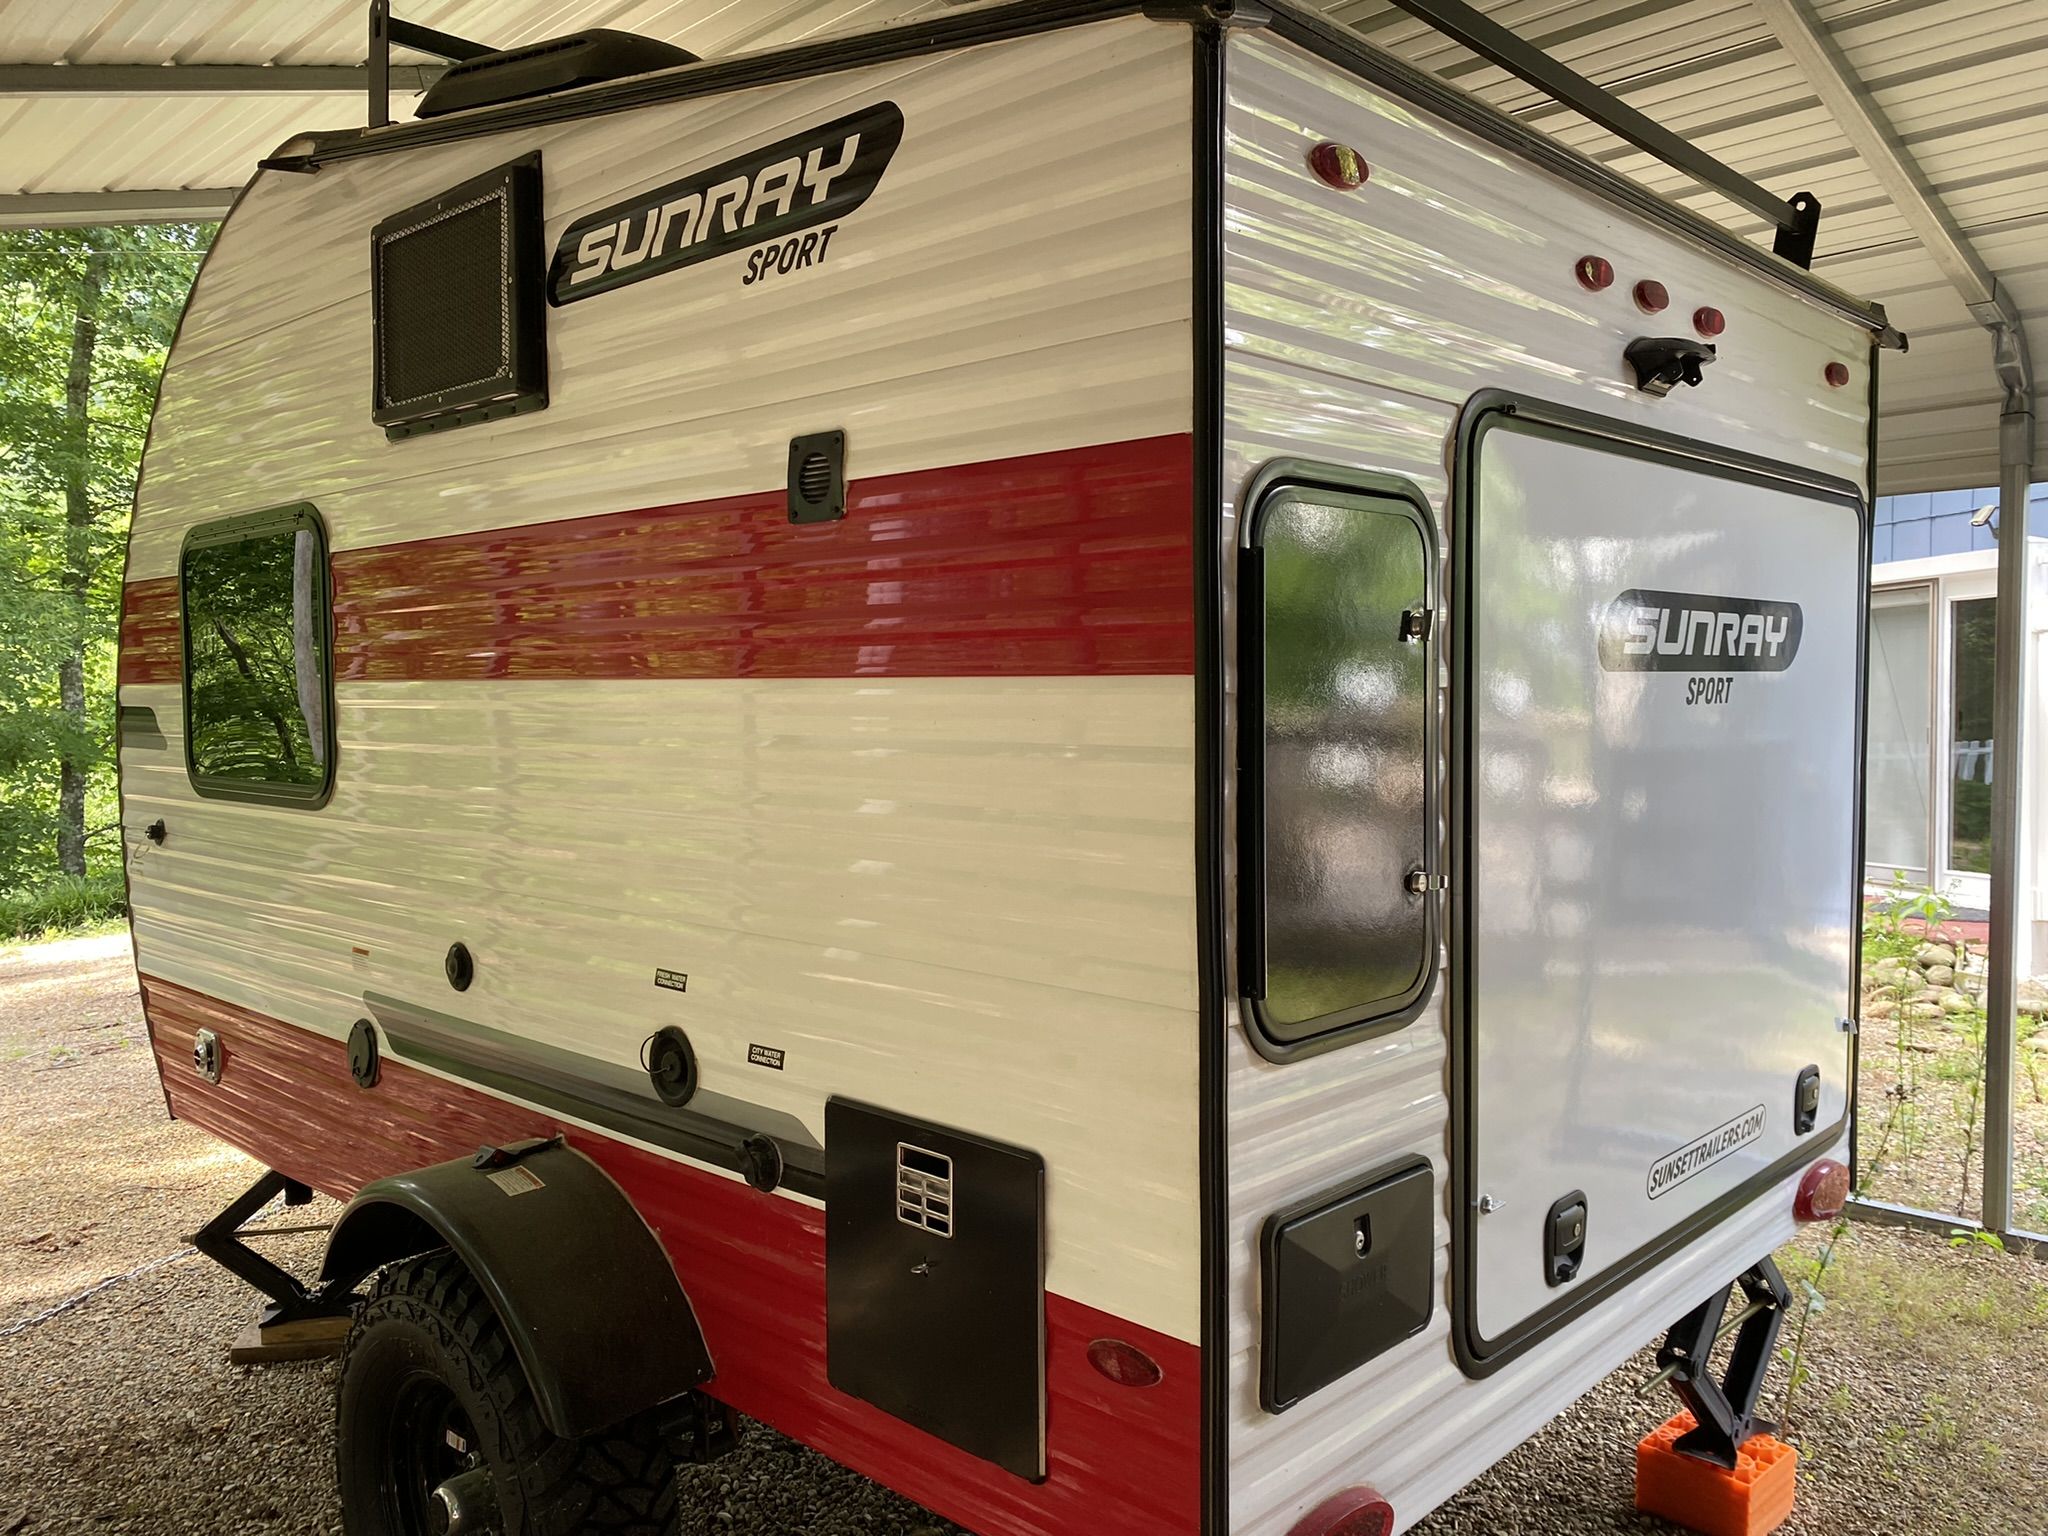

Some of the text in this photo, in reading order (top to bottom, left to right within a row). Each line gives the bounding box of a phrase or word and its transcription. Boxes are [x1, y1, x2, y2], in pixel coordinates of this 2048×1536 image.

[570, 133, 861, 285] SUNRAY
[742, 225, 839, 285] SPORT
[1623, 606, 1788, 657] SUNRAY
[1685, 677, 1734, 706] SPORT
[657, 977, 684, 990] CONNECTION
[671, 973, 686, 983] WATER
[750, 1053, 781, 1067] CONNECTION
[751, 1046, 781, 1060] CITY WATER
[1650, 1110, 1764, 1193] SUNSETTRAILERS.COM
